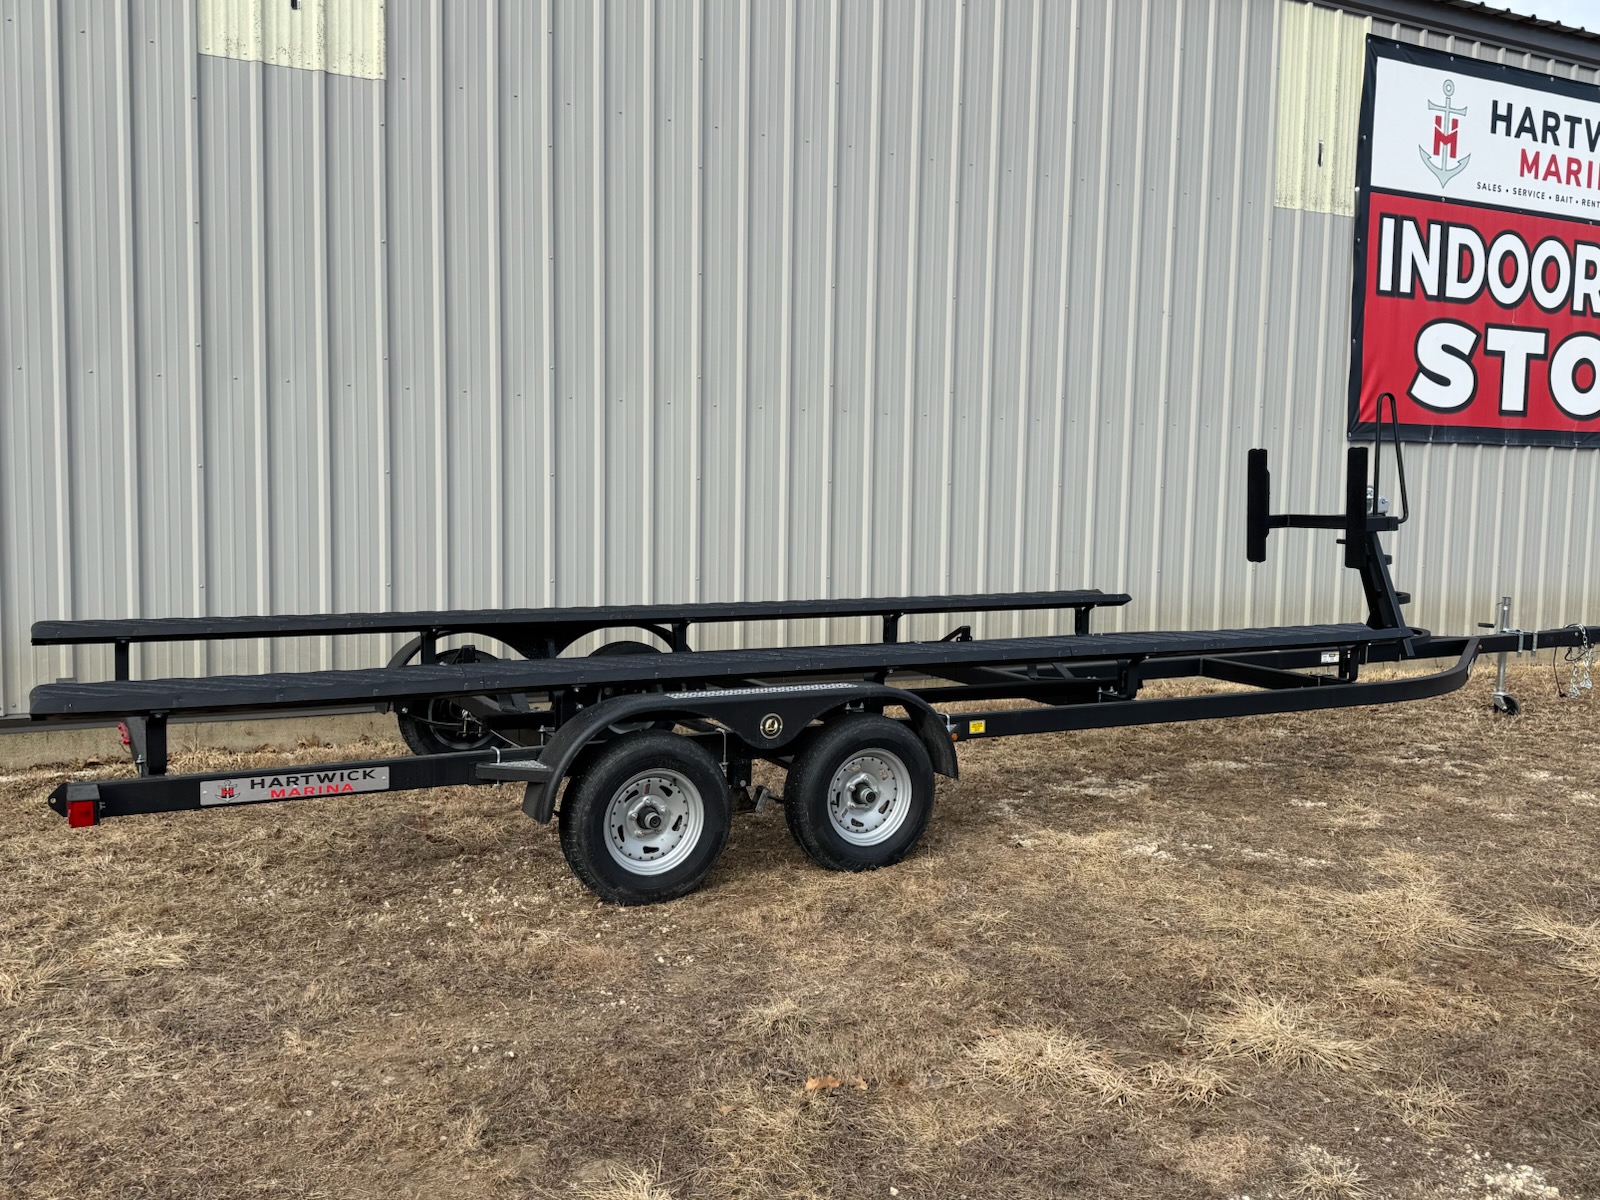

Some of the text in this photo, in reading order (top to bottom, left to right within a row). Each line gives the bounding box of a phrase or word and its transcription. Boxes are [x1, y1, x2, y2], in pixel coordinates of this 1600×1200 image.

[1519, 148, 1600, 191] MARI
[1476, 181, 1502, 193] SALES
[1512, 187, 1546, 200] SERVICE
[1555, 194, 1573, 204] BAIT
[1377, 213, 1600, 317] INDOOR
[1407, 319, 1600, 420] STO
[250, 769, 376, 789] HARTWICK
[270, 783, 354, 799] MARINA
